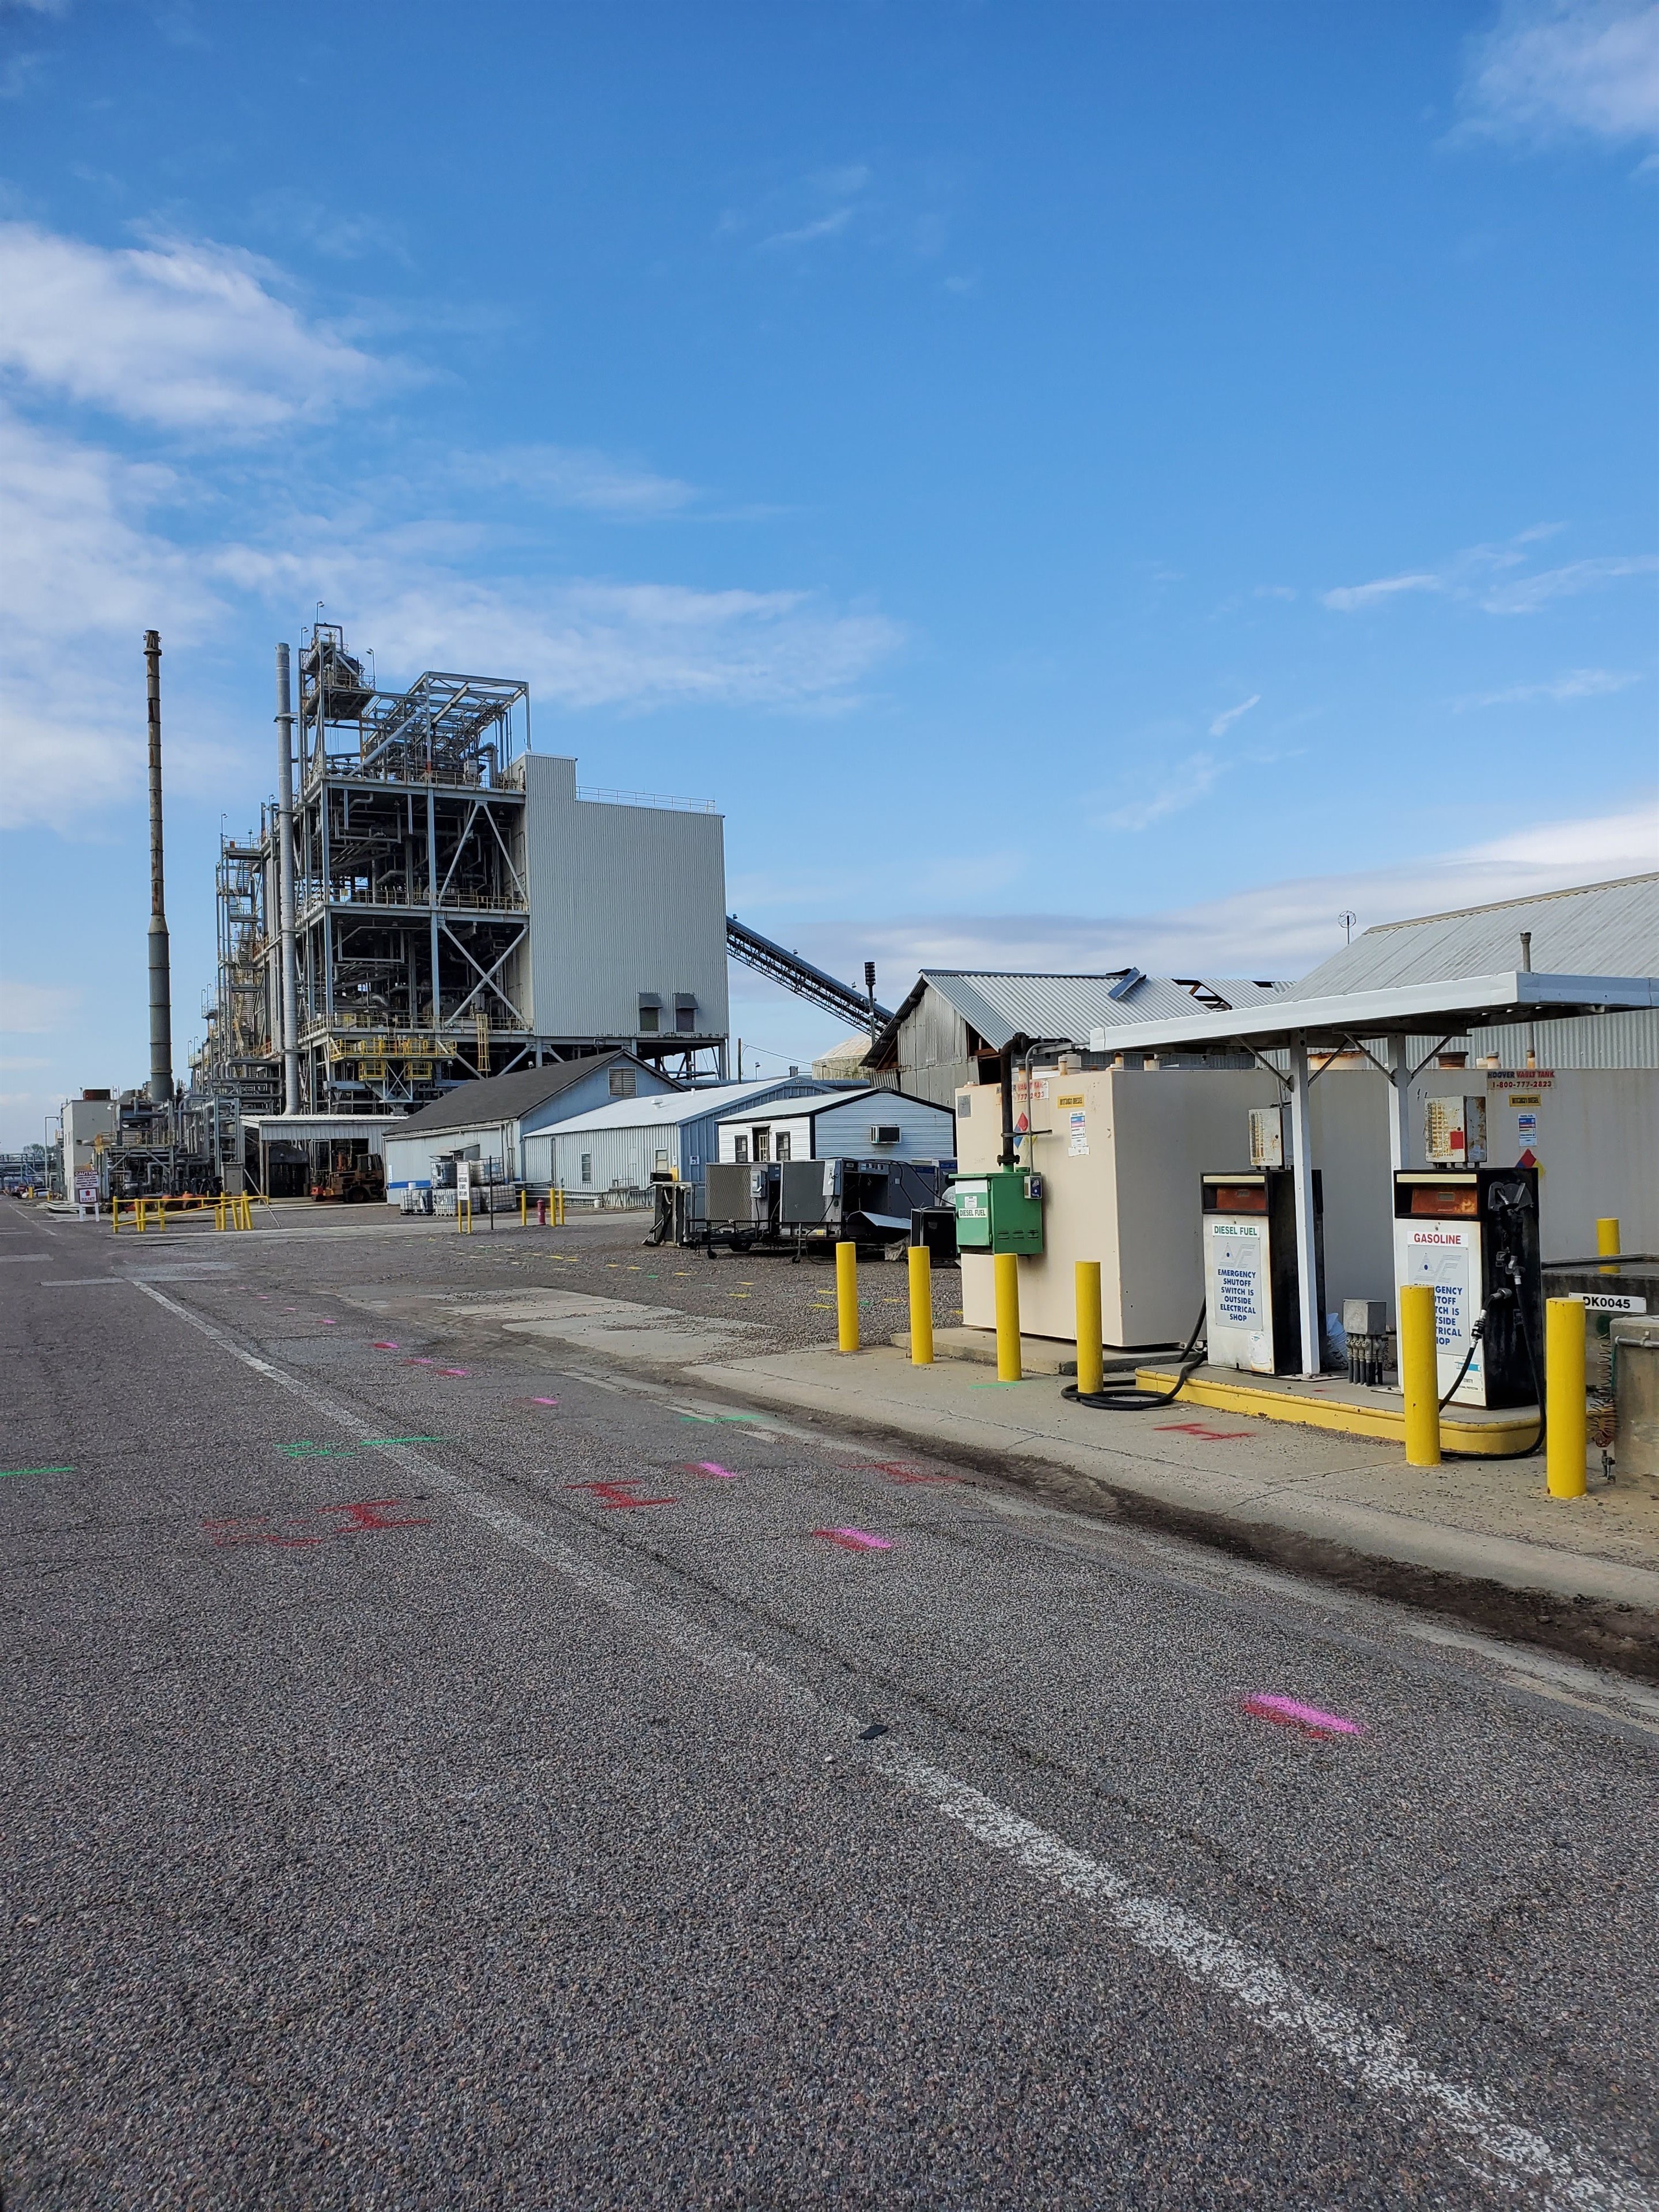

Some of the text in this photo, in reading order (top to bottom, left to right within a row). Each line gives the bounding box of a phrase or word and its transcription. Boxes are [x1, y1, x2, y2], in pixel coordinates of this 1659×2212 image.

[1516, 1070, 1536, 1078] VAULT
[1214, 1226, 1257, 1236] DIESEL FUEL
[1414, 1233, 1461, 1245] GASOLINE
[1218, 1268, 1256, 1279] EMERGENCY
[1223, 1278, 1251, 1287] SHUTOFF
[1221, 1286, 1245, 1296] SWITCH
[1224, 1296, 1251, 1305] OUTSIDE
[1583, 1296, 1631, 1309] DK0045
[1220, 1304, 1256, 1315] ELECTRICAL
[1452, 1308, 1459, 1316] IS
[1229, 1313, 1247, 1321] SHOP
